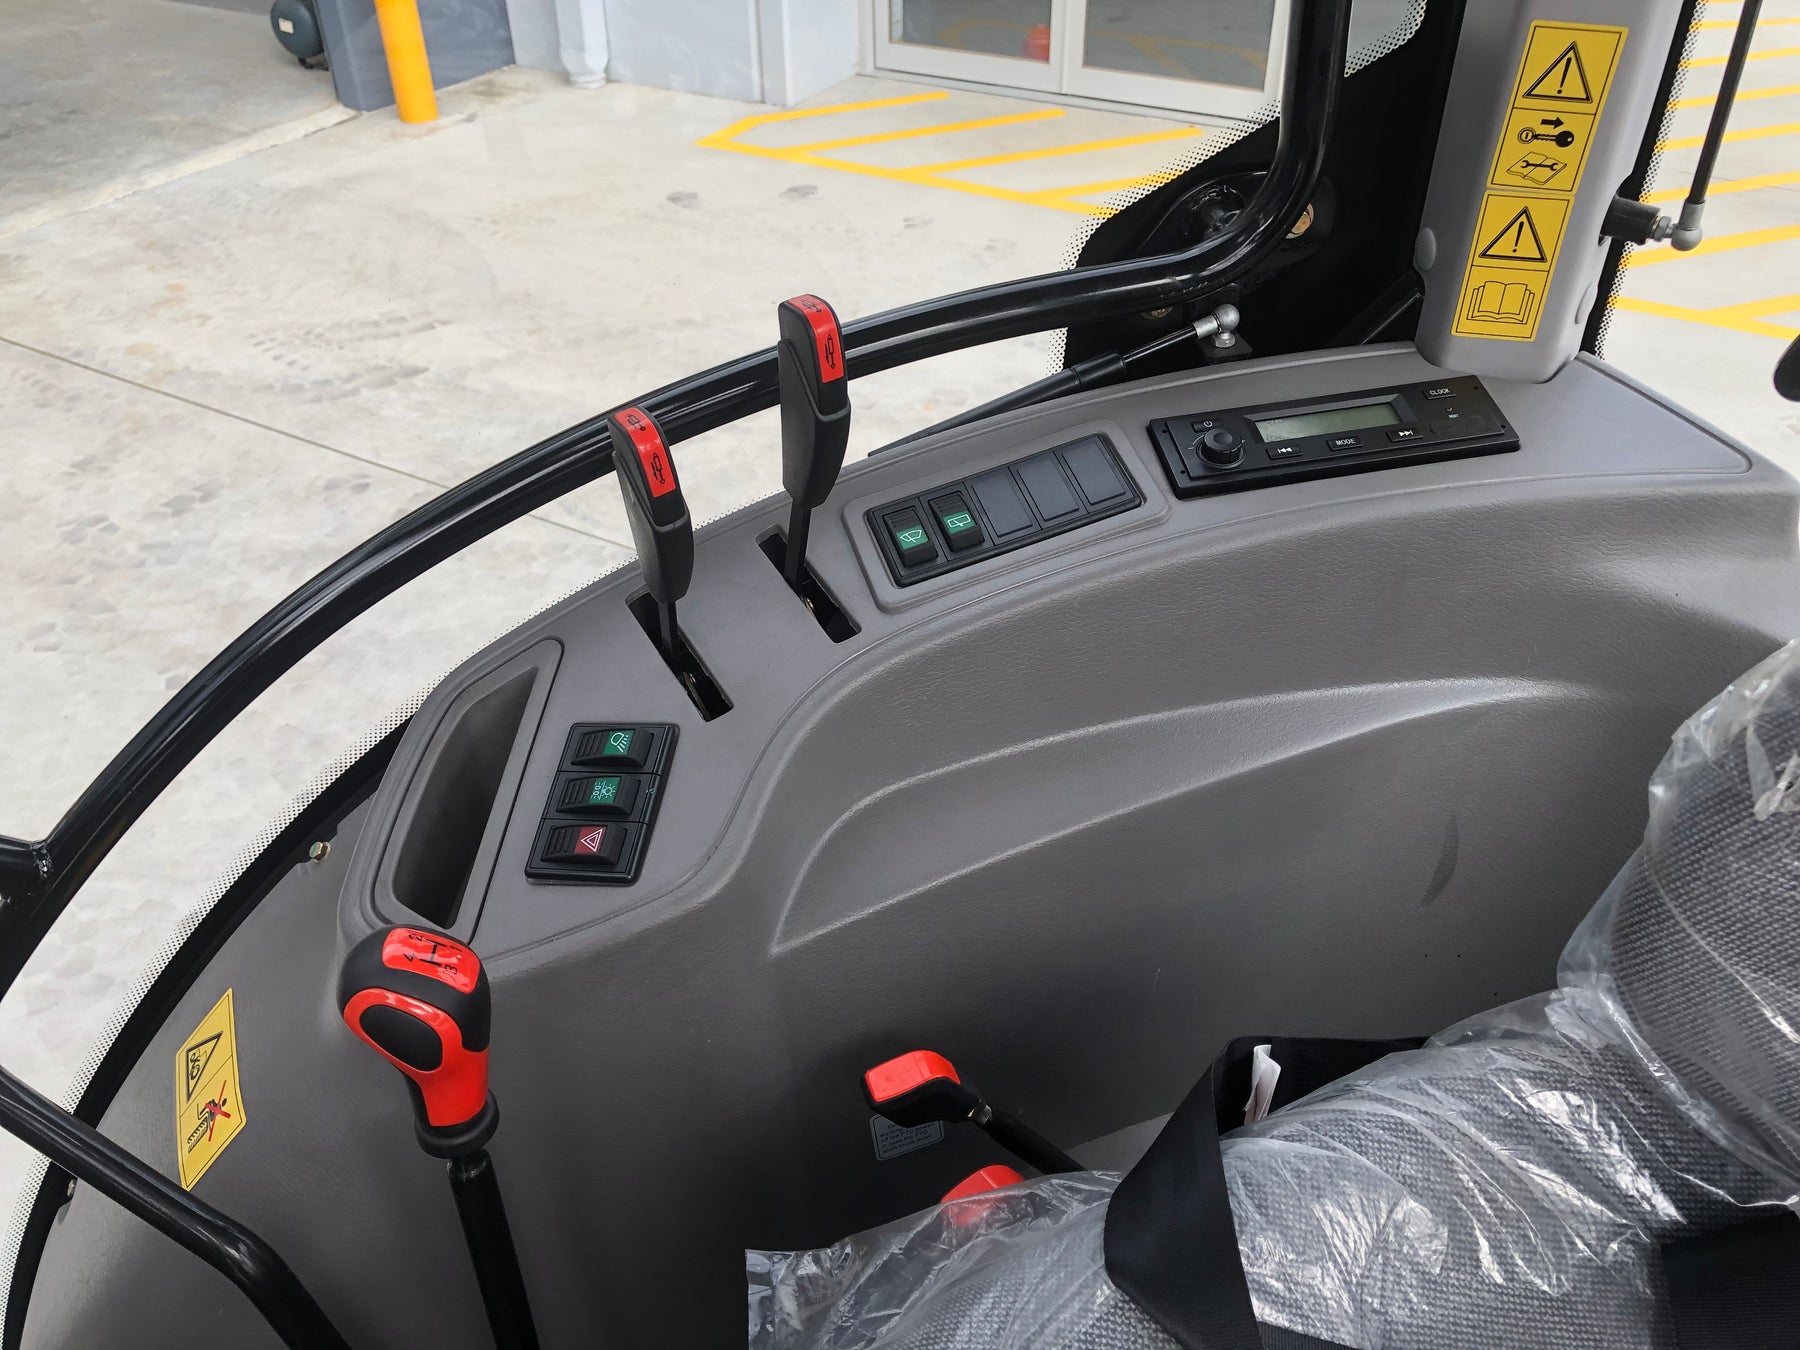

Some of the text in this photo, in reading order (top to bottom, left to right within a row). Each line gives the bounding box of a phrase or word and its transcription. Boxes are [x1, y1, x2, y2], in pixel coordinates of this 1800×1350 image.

[1429, 388, 1451, 396] CLOCK
[1335, 438, 1356, 446] MODE
[408, 933, 423, 941] 2
[403, 953, 416, 962] 4
[444, 964, 458, 975] 3
